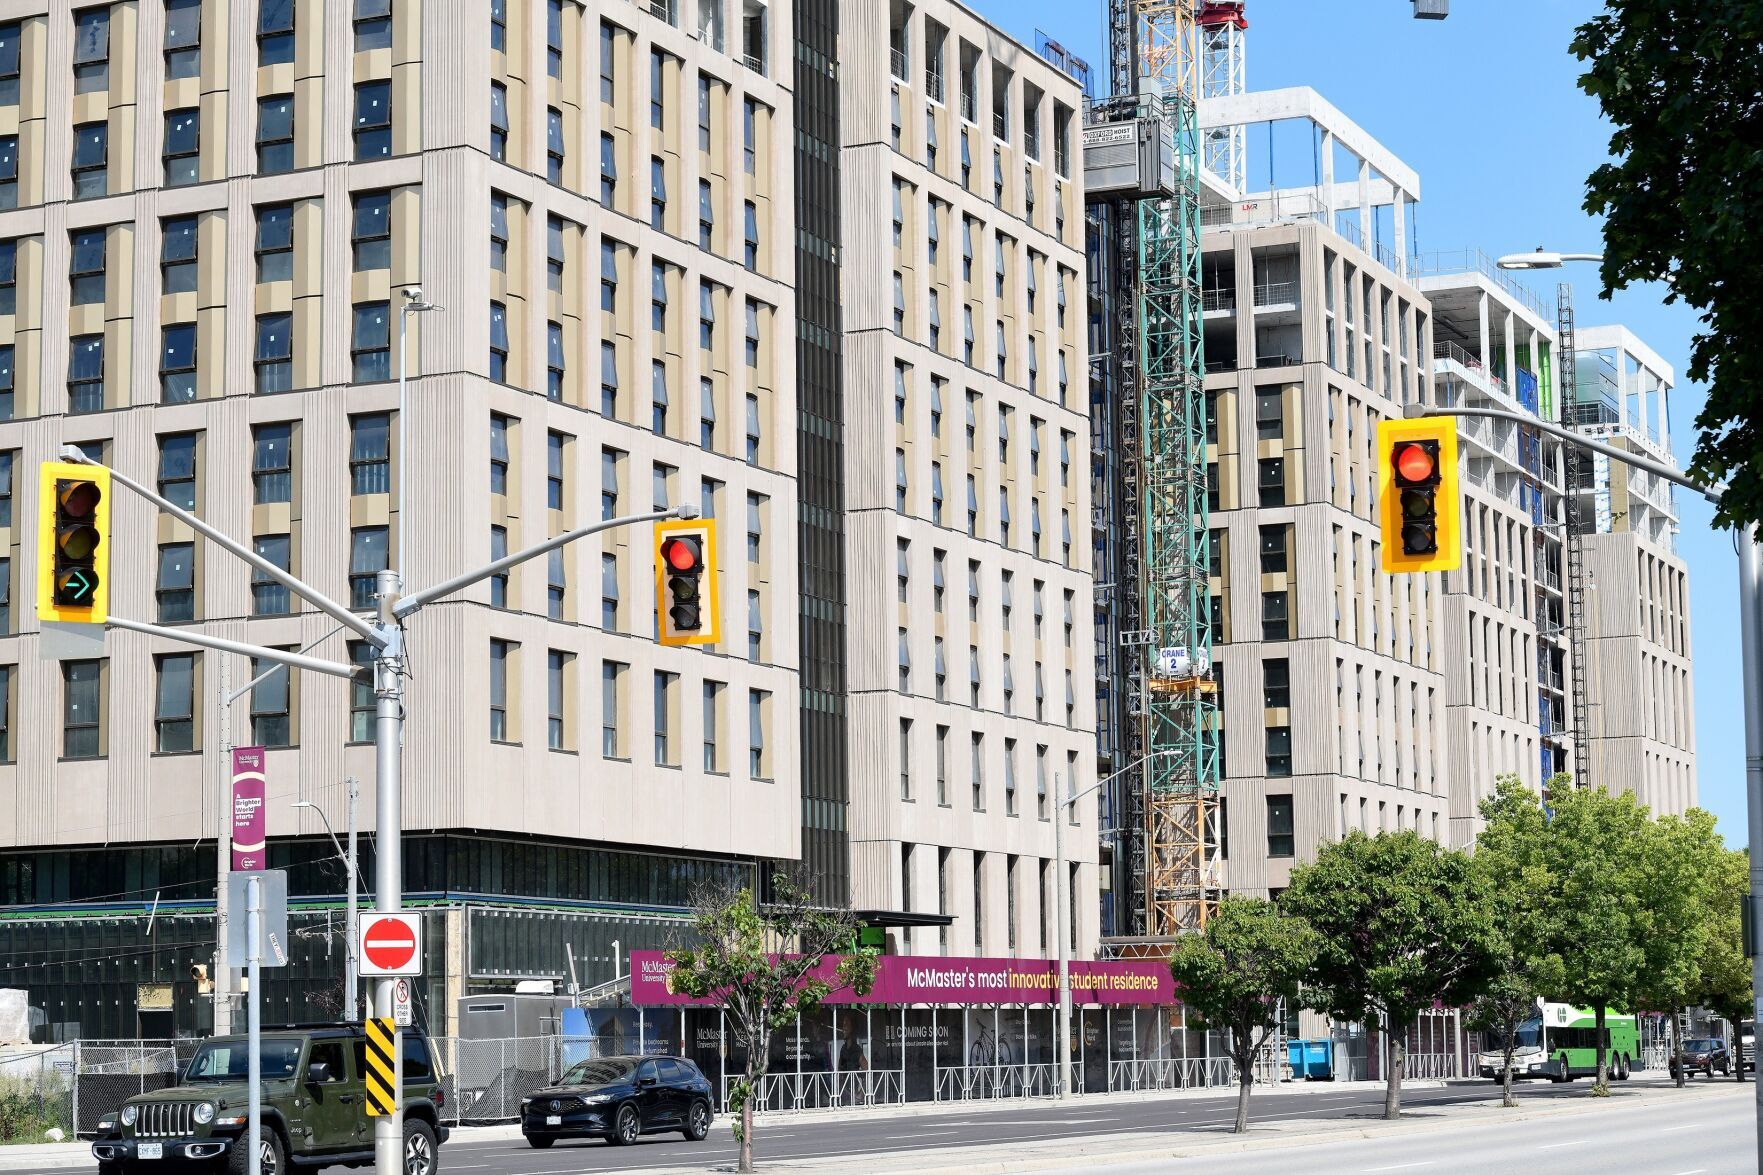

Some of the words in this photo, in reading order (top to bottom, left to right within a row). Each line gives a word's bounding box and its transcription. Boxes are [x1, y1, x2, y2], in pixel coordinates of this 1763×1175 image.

[1089, 129, 1113, 139] OXFORD
[1113, 127, 1131, 135] HOIST
[1161, 649, 1185, 658] CRANE
[1170, 658, 1177, 669] 2
[235, 799, 261, 807] Brighter
[641, 974, 666, 984] University
[907, 966, 975, 988] McMaster's
[978, 970, 1008, 988] most
[1009, 968, 1060, 989] innovativ
[1110, 971, 1158, 990] residence
[697, 1041, 719, 1050] University
